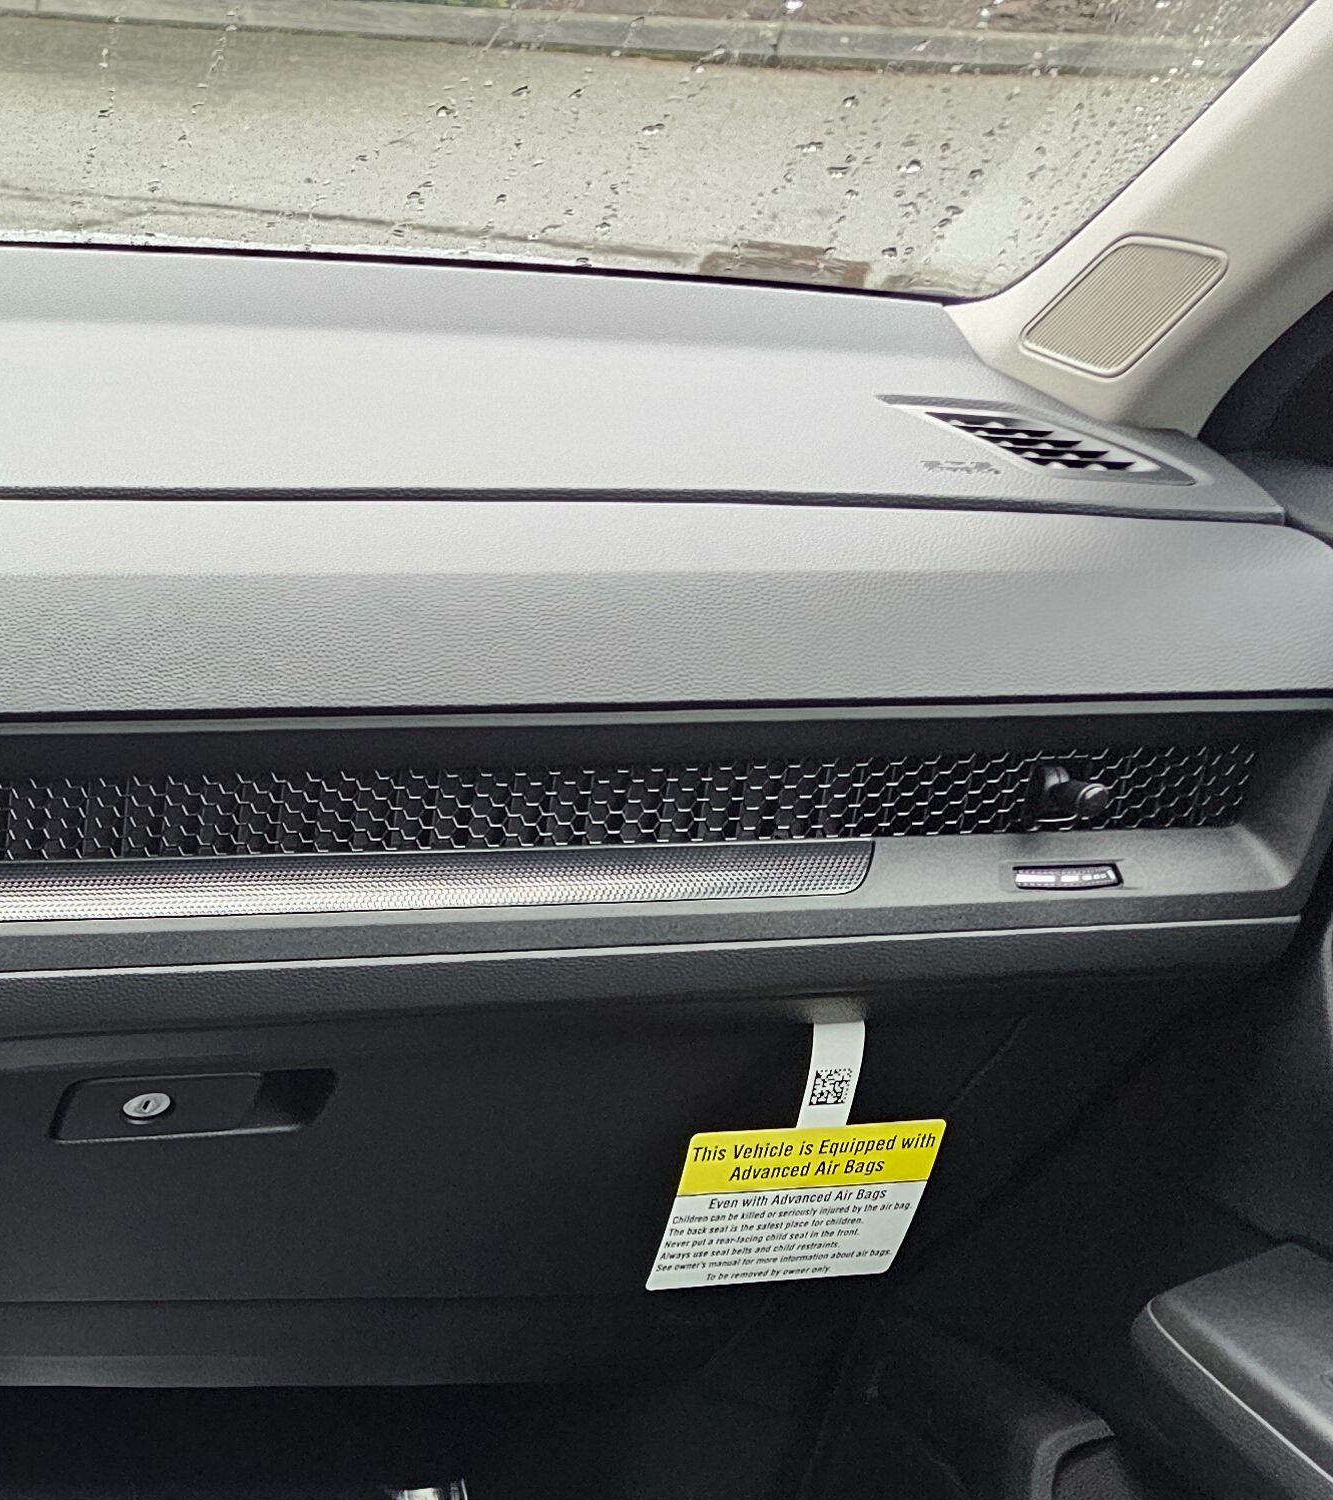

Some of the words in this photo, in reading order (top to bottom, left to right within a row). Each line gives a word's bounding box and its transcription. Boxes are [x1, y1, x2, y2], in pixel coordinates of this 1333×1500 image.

[692, 1146, 726, 1162] This
[733, 1142, 792, 1160] Vehicle
[799, 1140, 813, 1156] is
[818, 1135, 896, 1157] Equipped
[902, 1133, 936, 1148] with
[729, 1162, 808, 1182] Advanced
[814, 1160, 839, 1176] Air
[844, 1159, 885, 1177] Bags
[708, 1198, 738, 1210] Even
[742, 1196, 769, 1208] with
[771, 1192, 831, 1206] Advanced
[834, 1190, 854, 1202] Air
[856, 1188, 887, 1202] Bags
[672, 1215, 708, 1225] Children
[710, 1215, 726, 1223] can
[728, 1213, 738, 1221] be
[740, 1210, 765, 1219] killed
[767, 1210, 777, 1218] or
[778, 1208, 817, 1218] seriously
[819, 1205, 849, 1215] injured
[852, 1205, 861, 1214] by
[864, 1203, 878, 1212] the
[880, 1202, 892, 1210] air
[894, 1201, 913, 1210] bag.
[664, 1240, 690, 1249] Never
[691, 1238, 706, 1248] put
[715, 1235, 763, 1245] rear-facing
[765, 1233, 787, 1241] child
[789, 1231, 808, 1240] seat
[810, 1231, 819, 1239] in
[821, 1229, 835, 1238] the
[669, 1229, 684, 1237] The
[687, 1226, 706, 1235] back
[708, 1225, 728, 1234] seat
[729, 1224, 738, 1232] is
[740, 1223, 754, 1231] the
[756, 1222, 783, 1231] safest
[785, 1220, 809, 1230] place
[811, 1219, 823, 1227] for
[656, 1264, 672, 1272] See
[674, 1261, 706, 1271] owner's
[708, 1259, 741, 1268] manual
[742, 1258, 754, 1266] for
[756, 1256, 778, 1265] more
[779, 1253, 828, 1263] information
[830, 1250, 854, 1259] about
[855, 1249, 868, 1257] air
[660, 1252, 691, 1261] Always
[711, 1249, 730, 1257] seat
[732, 1247, 752, 1255] belts
[754, 1245, 771, 1253] and
[773, 1244, 795, 1253] child
[707, 1272, 716, 1281] To
[718, 1271, 729, 1280] be
[731, 1269, 769, 1278] removed
[771, 1267, 781, 1277] by
[782, 1267, 810, 1275] owner
